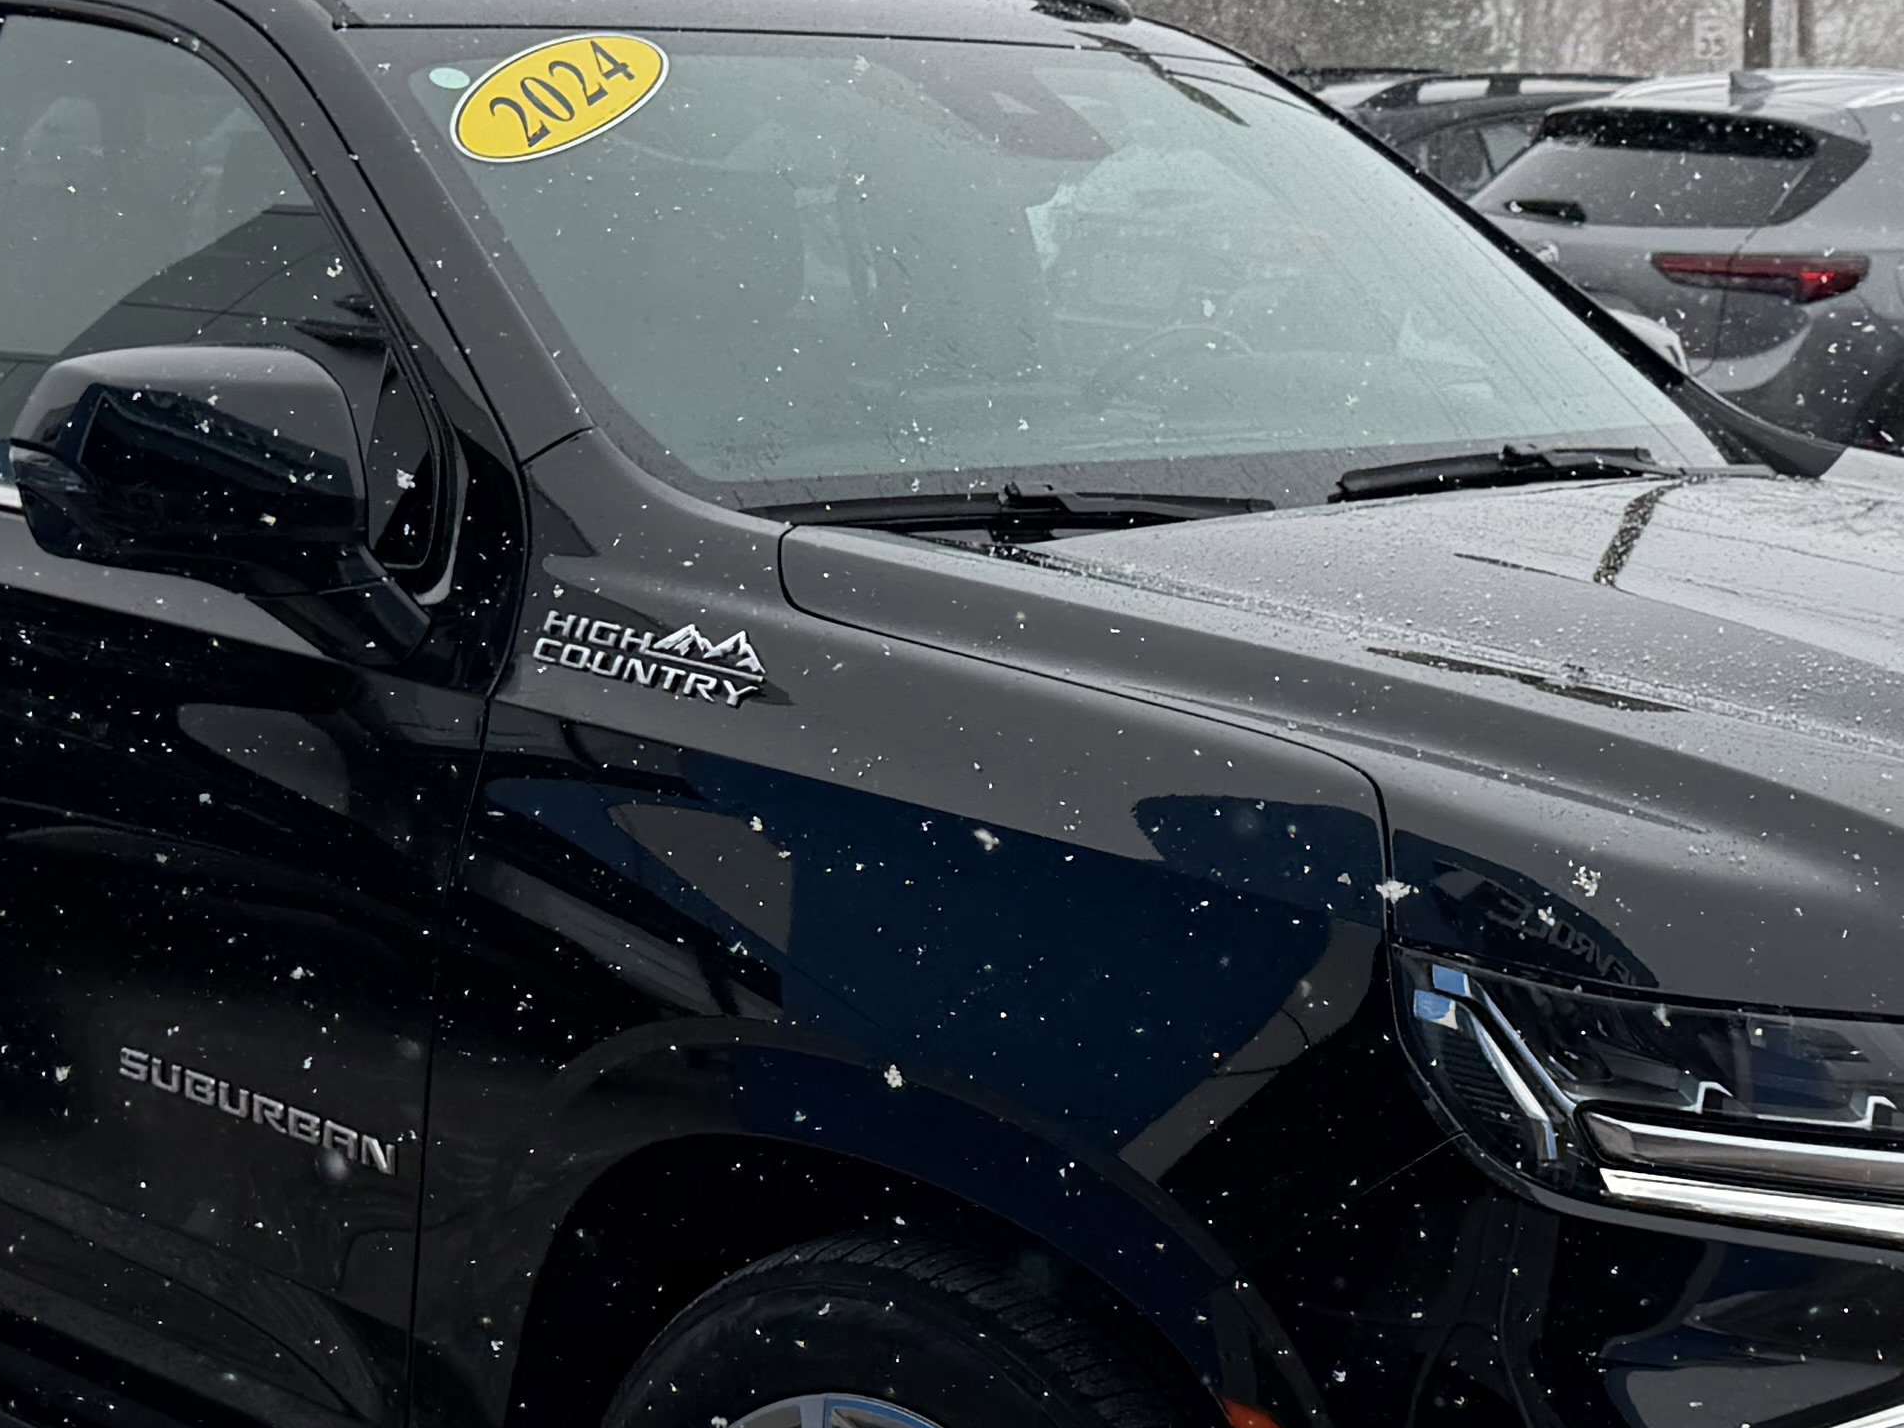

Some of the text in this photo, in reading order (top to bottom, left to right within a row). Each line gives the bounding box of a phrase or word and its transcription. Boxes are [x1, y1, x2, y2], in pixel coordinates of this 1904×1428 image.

[489, 40, 636, 148] 2024
[532, 636, 759, 708] COUNTRY
[543, 609, 655, 654] HIGH
[119, 1046, 396, 1176] SUBURBAN
